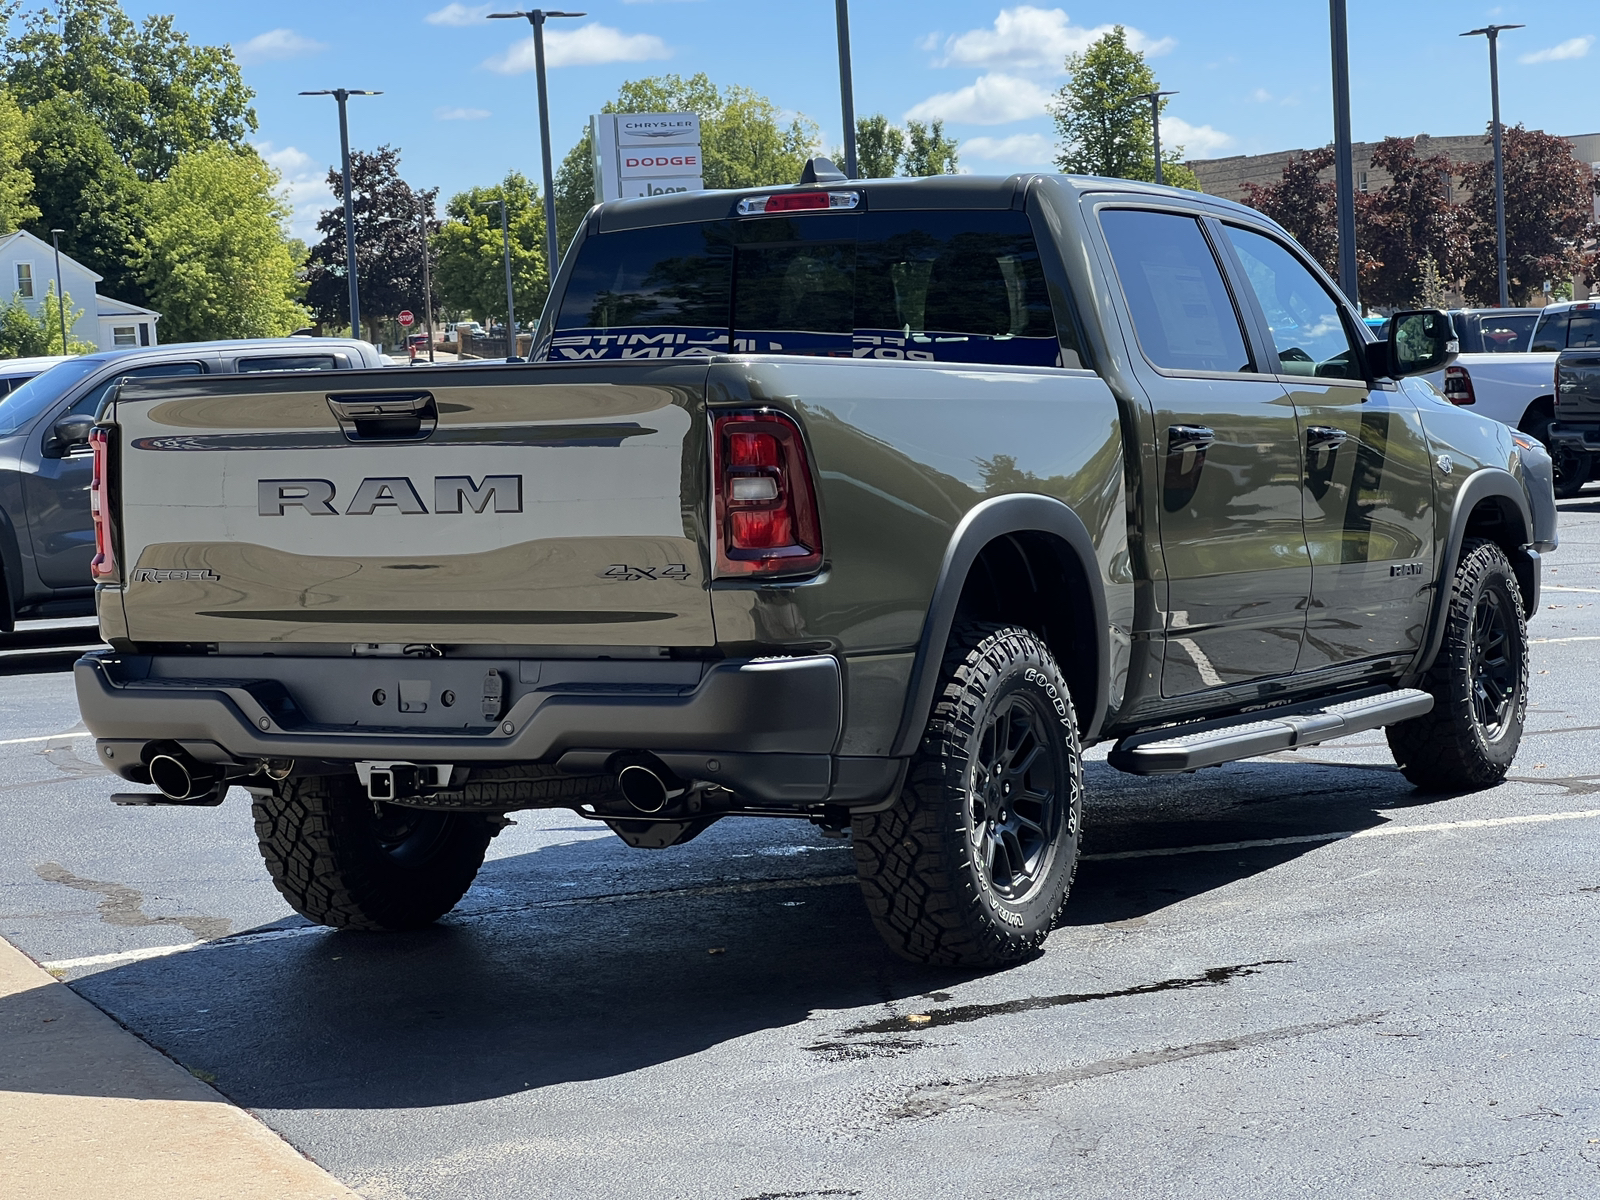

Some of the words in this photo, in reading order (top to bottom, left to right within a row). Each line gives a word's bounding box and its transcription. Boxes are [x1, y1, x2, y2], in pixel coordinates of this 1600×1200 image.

[625, 121, 692, 129] CHRYSLER
[626, 156, 697, 167] DODGE
[257, 474, 523, 516] RAM
[134, 568, 221, 583] REBEL
[1389, 562, 1424, 577] RAM
[1024, 667, 1077, 834] GOODYEAR
